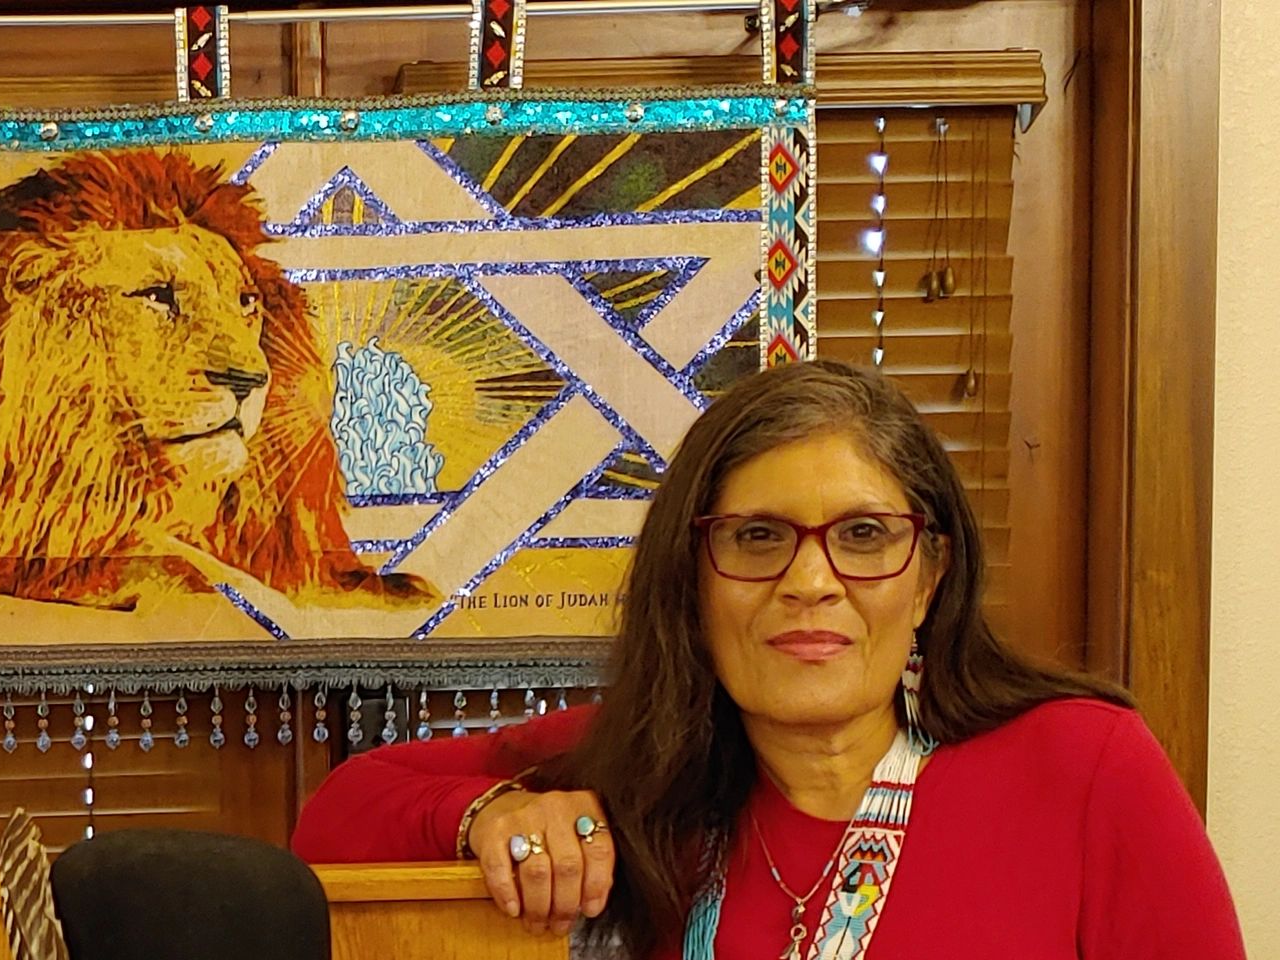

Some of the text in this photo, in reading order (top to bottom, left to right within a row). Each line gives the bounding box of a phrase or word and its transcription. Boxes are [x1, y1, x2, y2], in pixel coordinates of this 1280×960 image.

[493, 592, 529, 608] LION
[535, 593, 554, 608] OF
[558, 591, 608, 610] JUDAH
